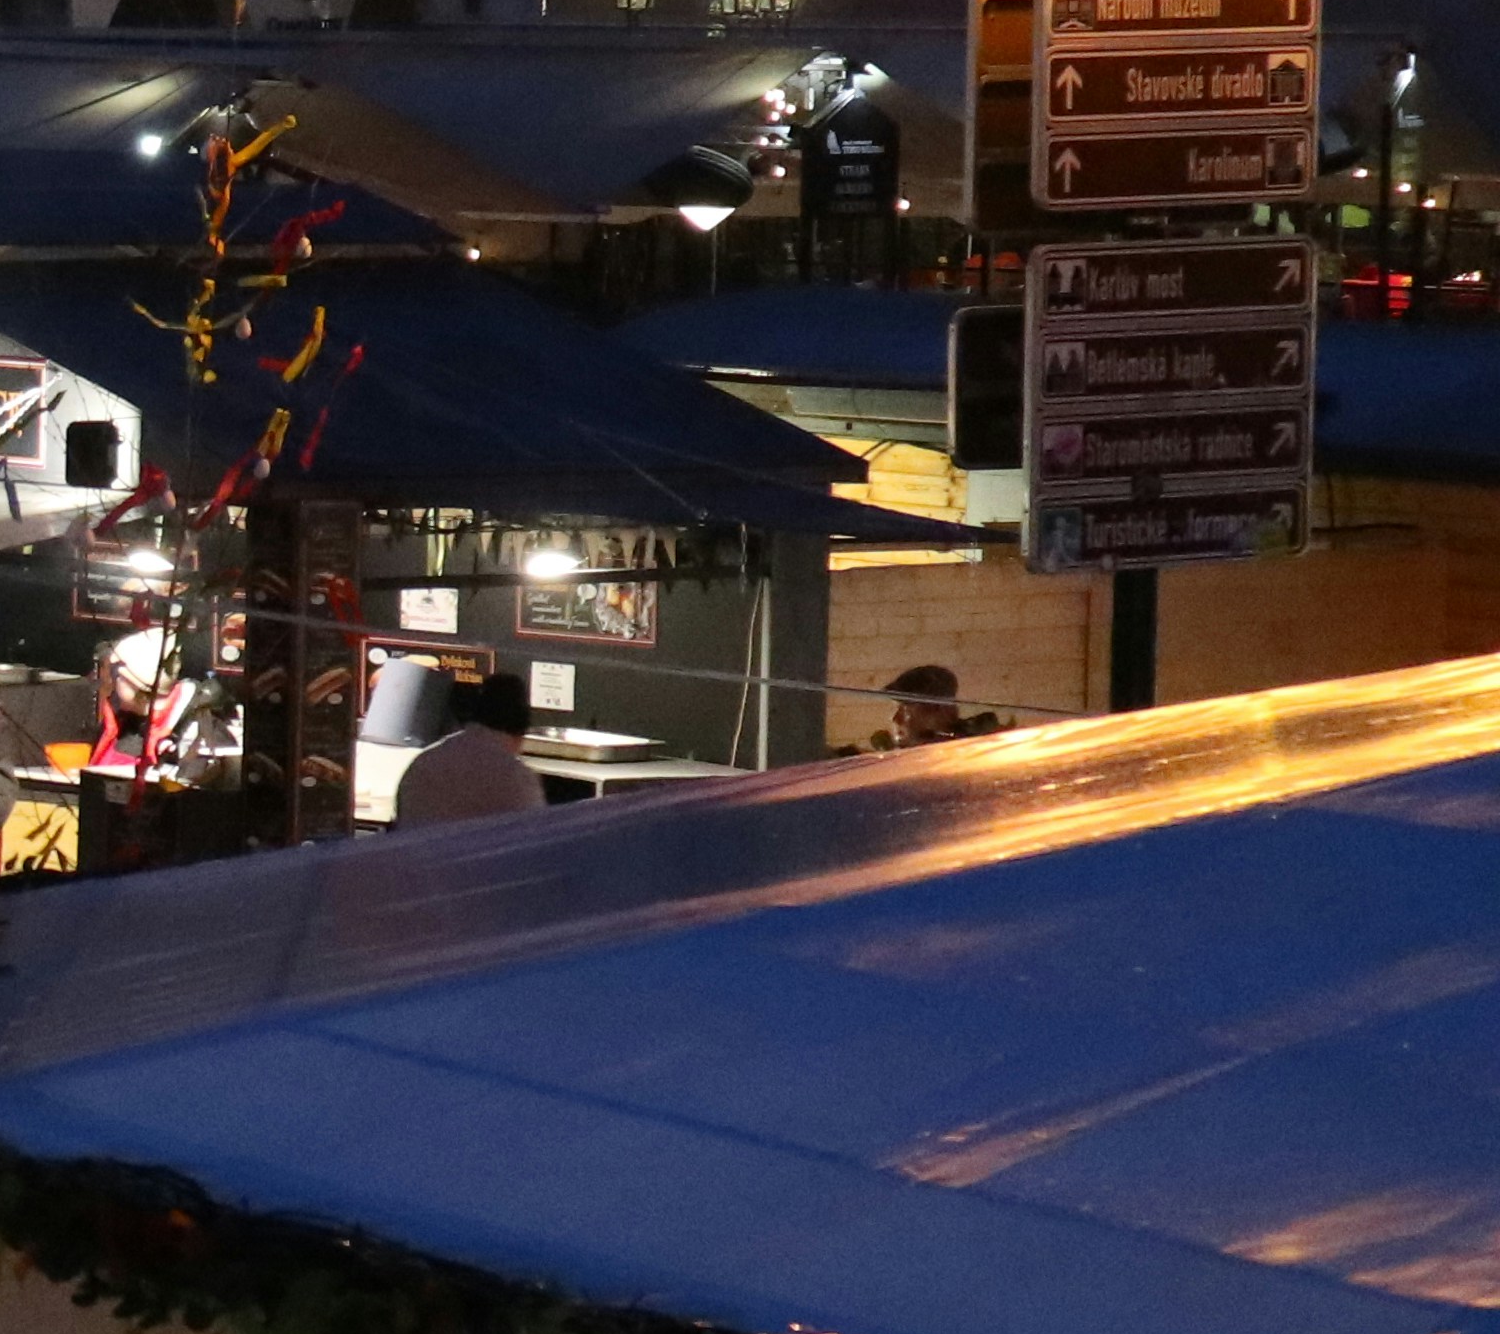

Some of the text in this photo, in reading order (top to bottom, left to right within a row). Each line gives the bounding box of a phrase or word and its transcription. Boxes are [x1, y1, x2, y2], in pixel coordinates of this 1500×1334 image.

[1126, 64, 1264, 103] Stavovské divadlo
[1188, 147, 1263, 183] Karolinum
[1088, 264, 1184, 301] Karlův most
